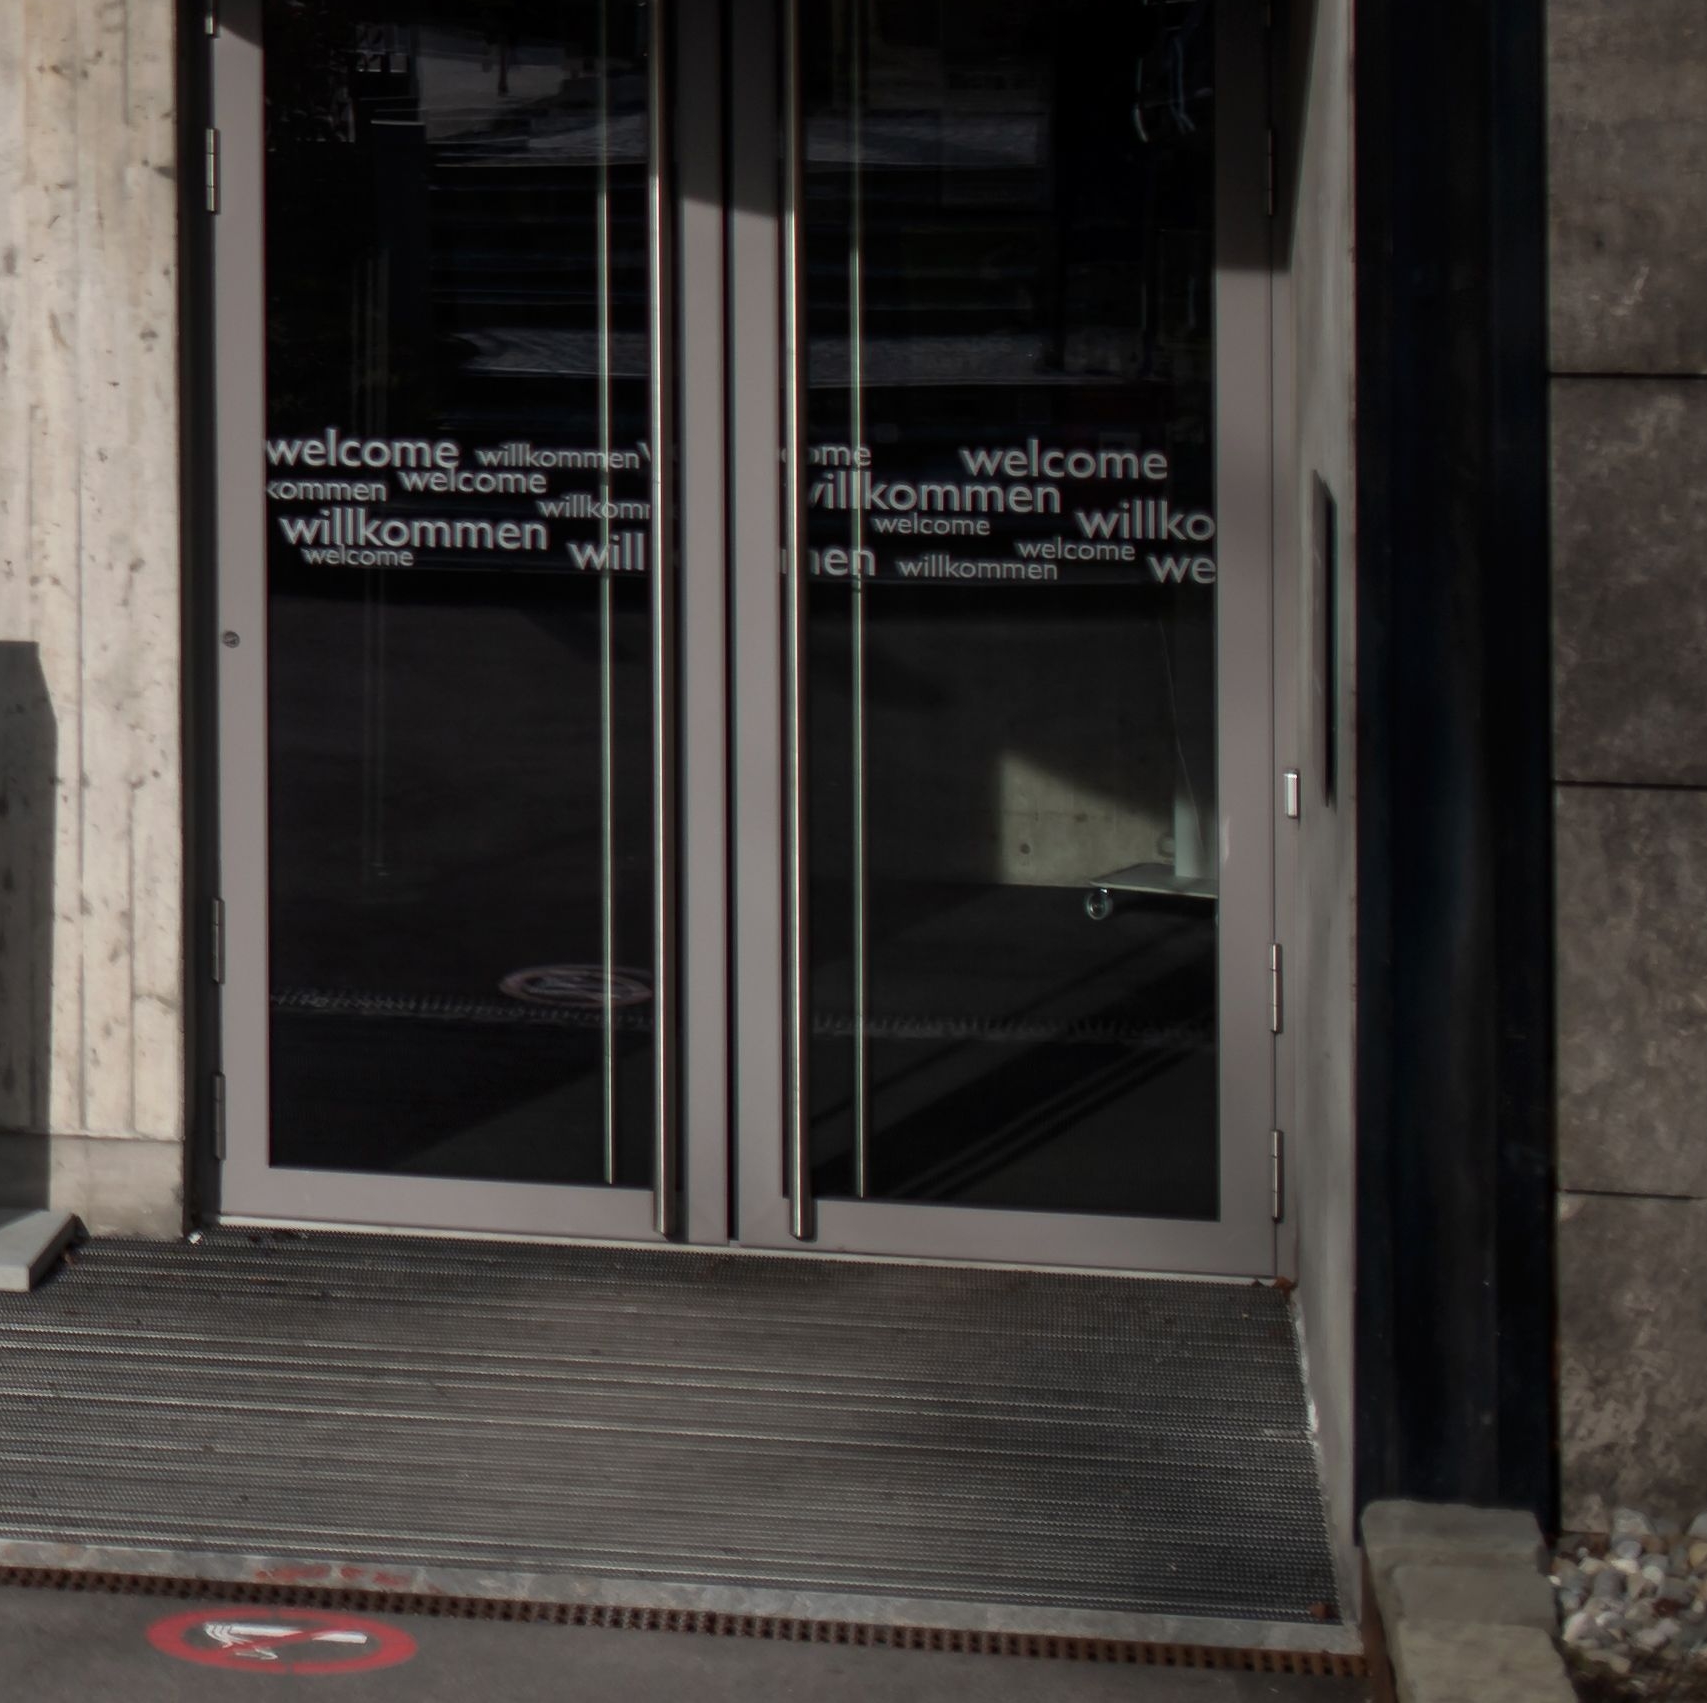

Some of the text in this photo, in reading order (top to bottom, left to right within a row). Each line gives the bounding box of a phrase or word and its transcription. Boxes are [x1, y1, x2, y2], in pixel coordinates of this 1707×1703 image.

[266, 428, 460, 468] welcome
[476, 442, 640, 470] willkommen
[960, 438, 1169, 480] welcome
[398, 463, 547, 494] welcome
[537, 493, 652, 521] willkom
[1074, 498, 1216, 542] willko
[279, 506, 548, 551] willkommen
[872, 511, 991, 537] welcome
[301, 542, 415, 568] welcome
[1014, 536, 1136, 563] welcome
[896, 553, 1058, 582] willkommen
[1147, 552, 1216, 586] we
